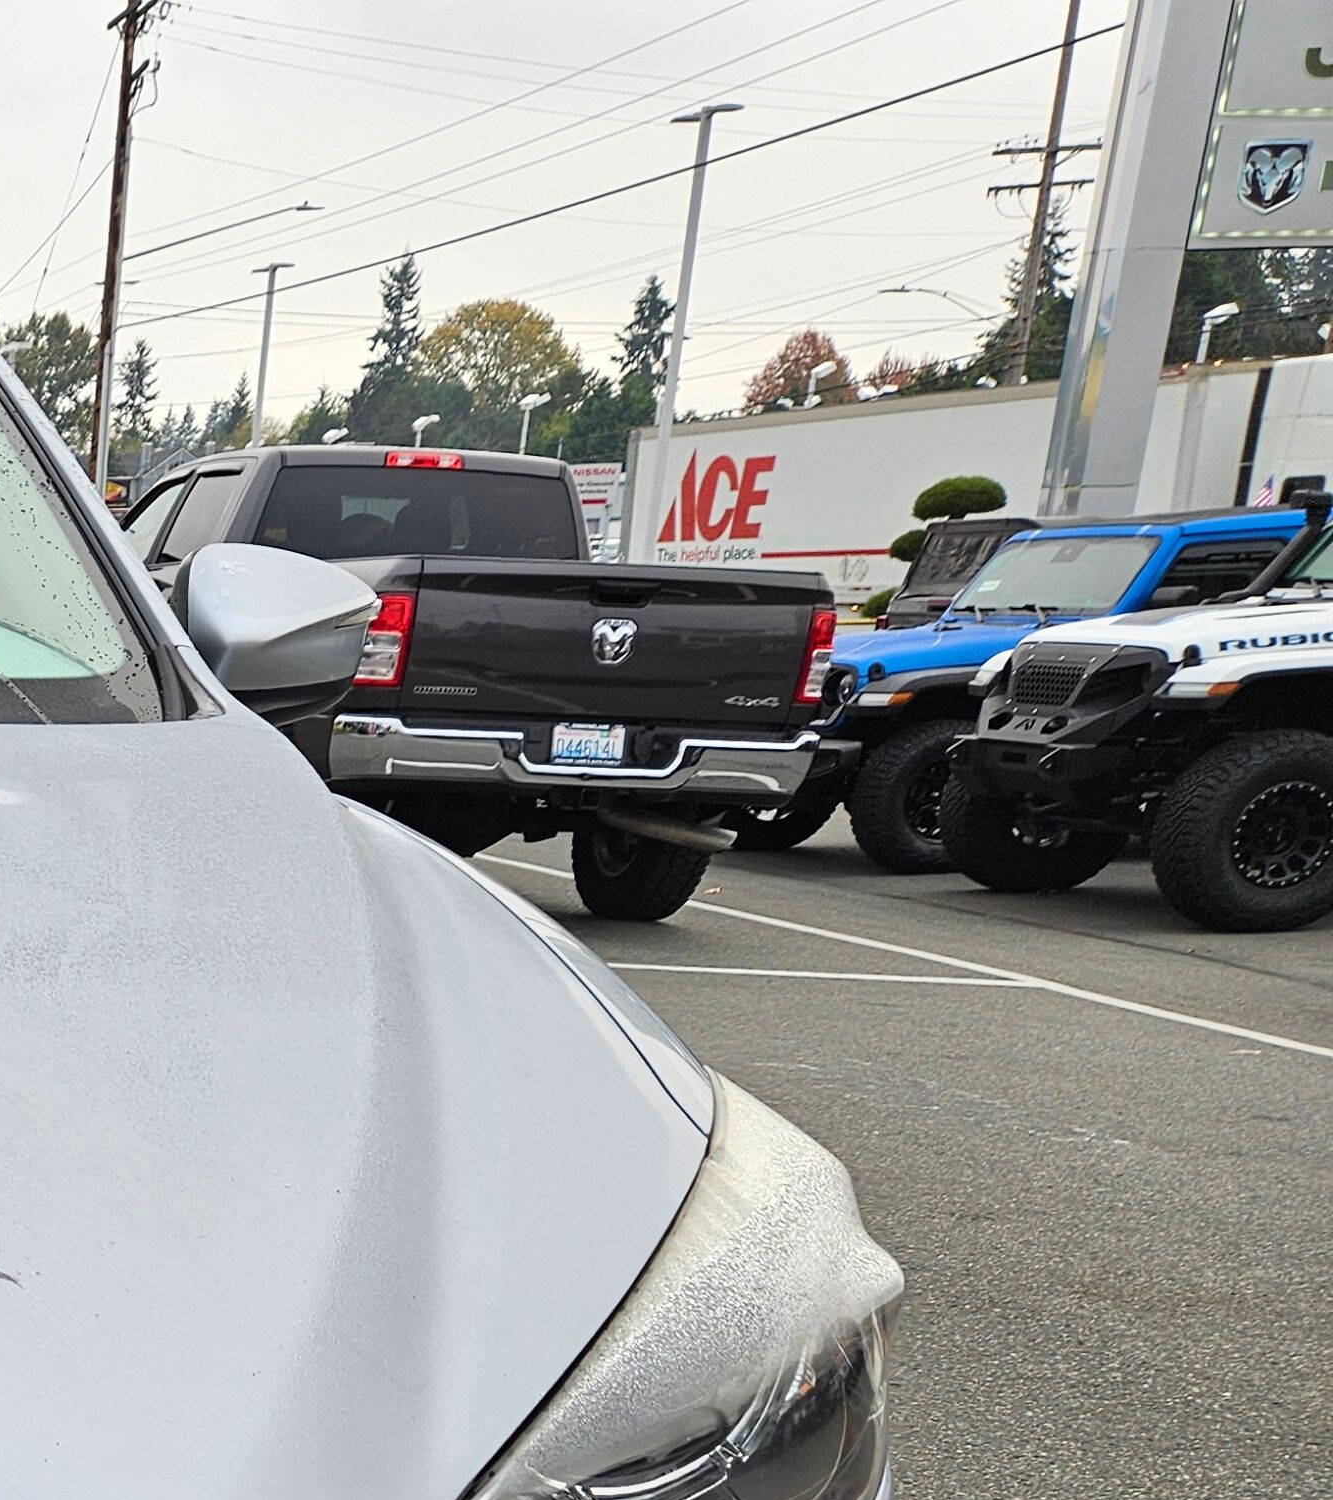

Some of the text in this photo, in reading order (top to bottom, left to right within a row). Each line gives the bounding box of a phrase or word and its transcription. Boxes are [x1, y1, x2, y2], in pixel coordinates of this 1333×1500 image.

[573, 467, 617, 476] NISSAN
[656, 446, 776, 542] ACE
[658, 548, 677, 562] The
[680, 546, 721, 563] helpful
[724, 695, 780, 707] 4x4
